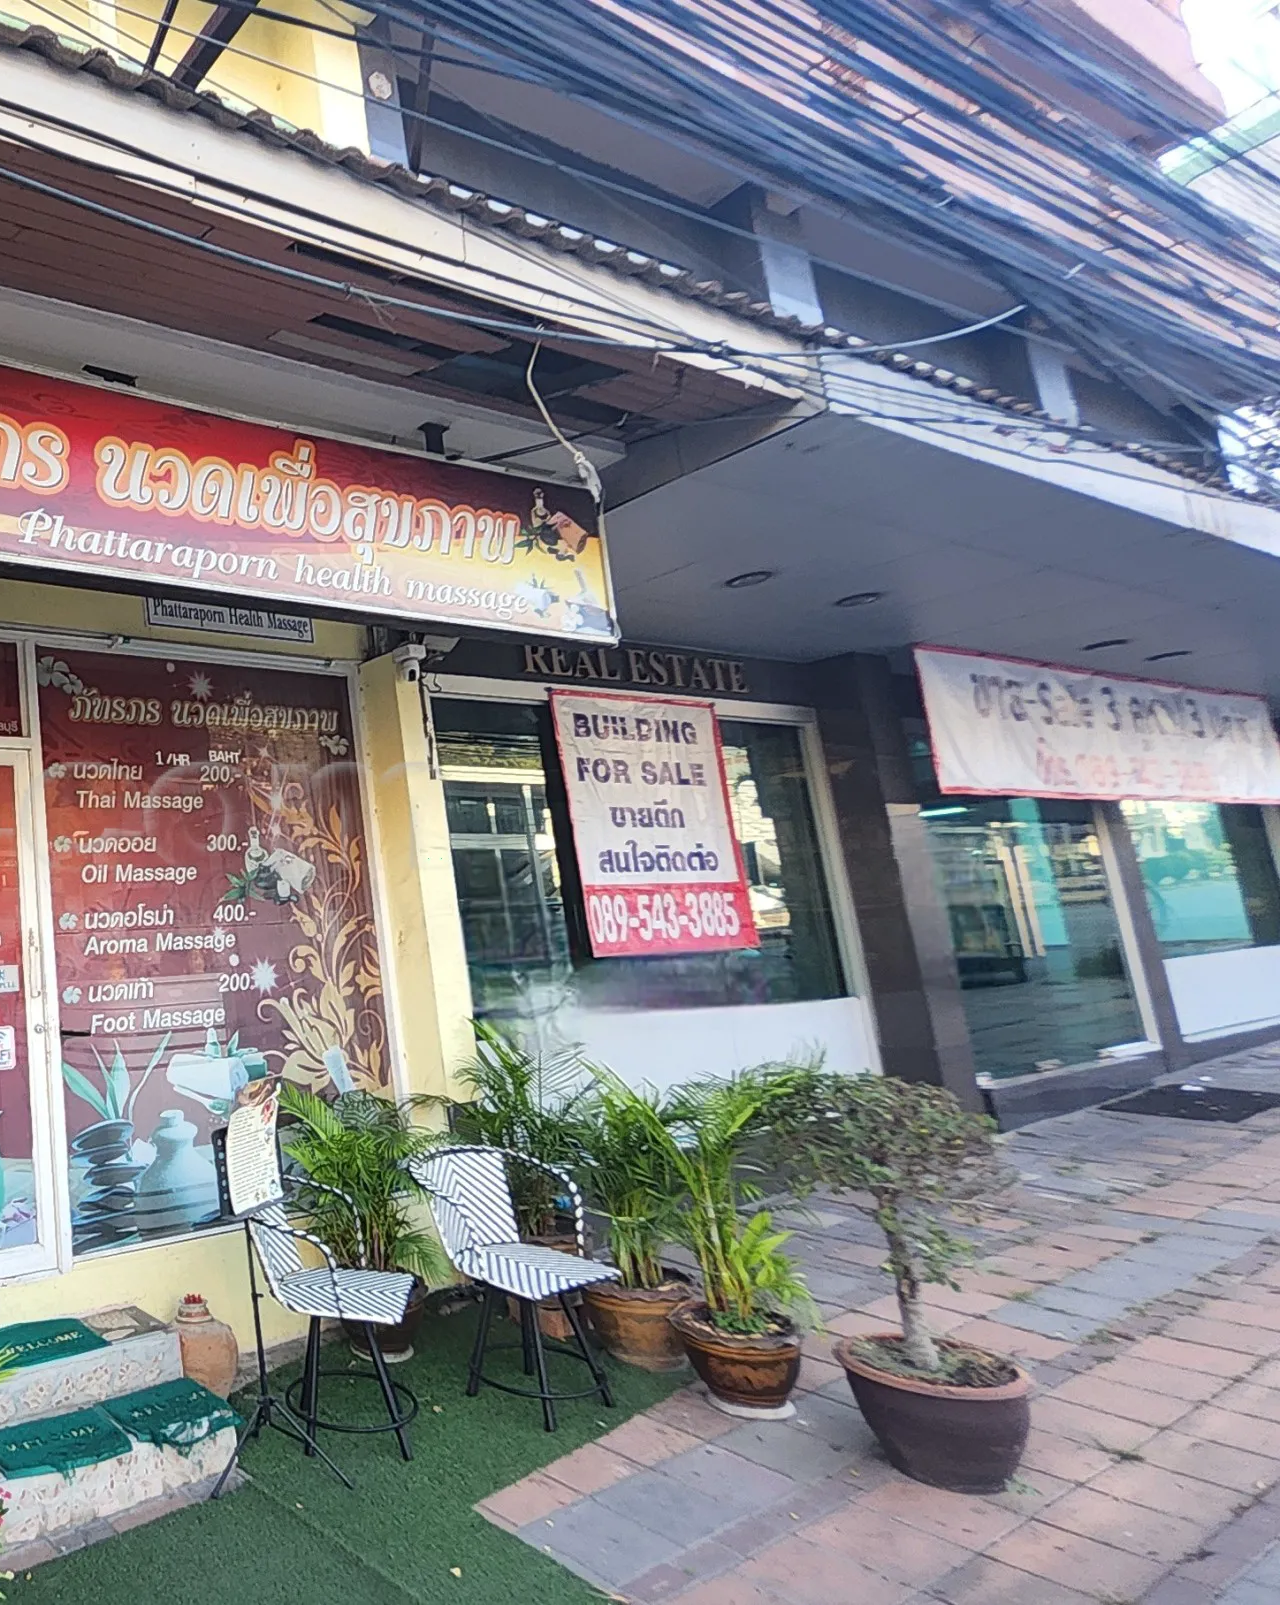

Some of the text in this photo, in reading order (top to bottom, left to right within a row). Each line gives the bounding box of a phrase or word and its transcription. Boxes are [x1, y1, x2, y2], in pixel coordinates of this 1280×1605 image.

[101, 442, 518, 566] นวดเพื่อสุขภาพ
[18, 508, 529, 618] Phattaraporn health massage
[153, 600, 224, 627] Phattaraporn
[229, 607, 263, 628] Health
[524, 644, 749, 693] REAL ESTATE
[70, 687, 161, 724] ภัทรภร
[573, 713, 697, 745] BUILDING
[73, 758, 143, 781] นวดไทย
[209, 749, 241, 764] BAHT
[576, 757, 707, 786] FOR SALE
[76, 790, 203, 813] Thai Massage
[207, 835, 248, 852] 300.-
[598, 839, 719, 873] สนใจติดต่อ
[81, 864, 197, 885] Oil Massage
[84, 904, 257, 928] นวดอโรม่า 400.-
[589, 892, 740, 944] 089-543-3885
[84, 933, 236, 956] Aroma Massage
[88, 977, 154, 1003] นวดเท้า
[91, 1006, 226, 1034] Foot Massage
